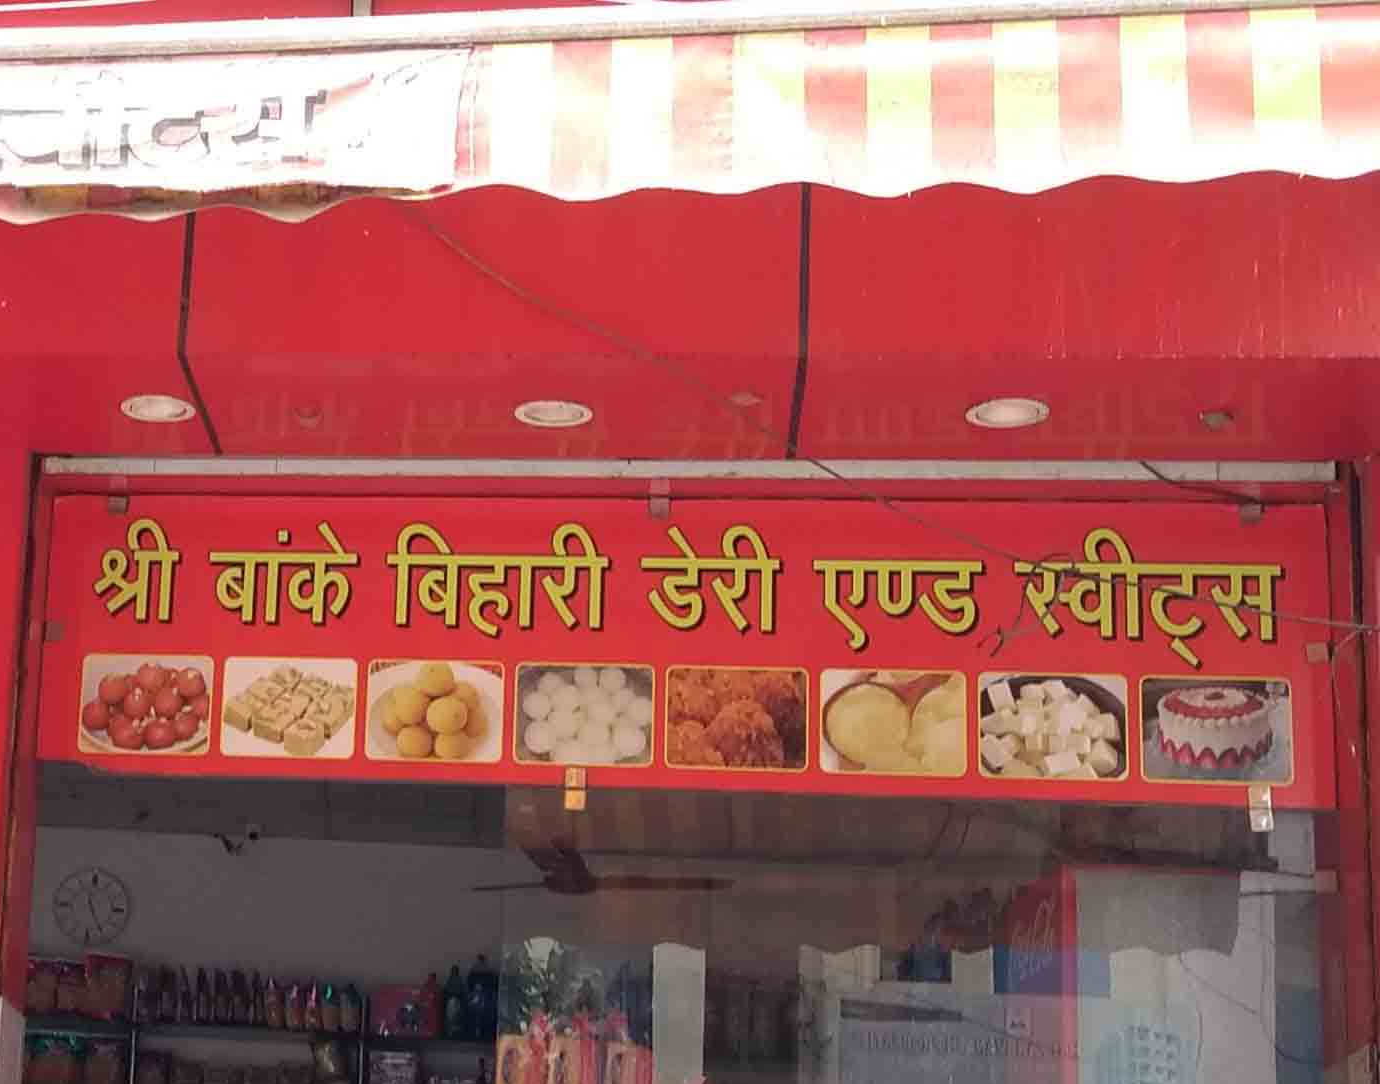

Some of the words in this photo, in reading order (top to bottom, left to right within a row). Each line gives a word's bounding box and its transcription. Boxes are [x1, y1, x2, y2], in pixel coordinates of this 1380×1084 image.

[93, 519, 180, 622] श्री
[210, 522, 359, 627] बांके
[387, 522, 610, 638] बिहारी
[641, 526, 780, 635] डेरी
[814, 560, 984, 651] एण्ड
[1015, 528, 1284, 670] स्वीट्स
